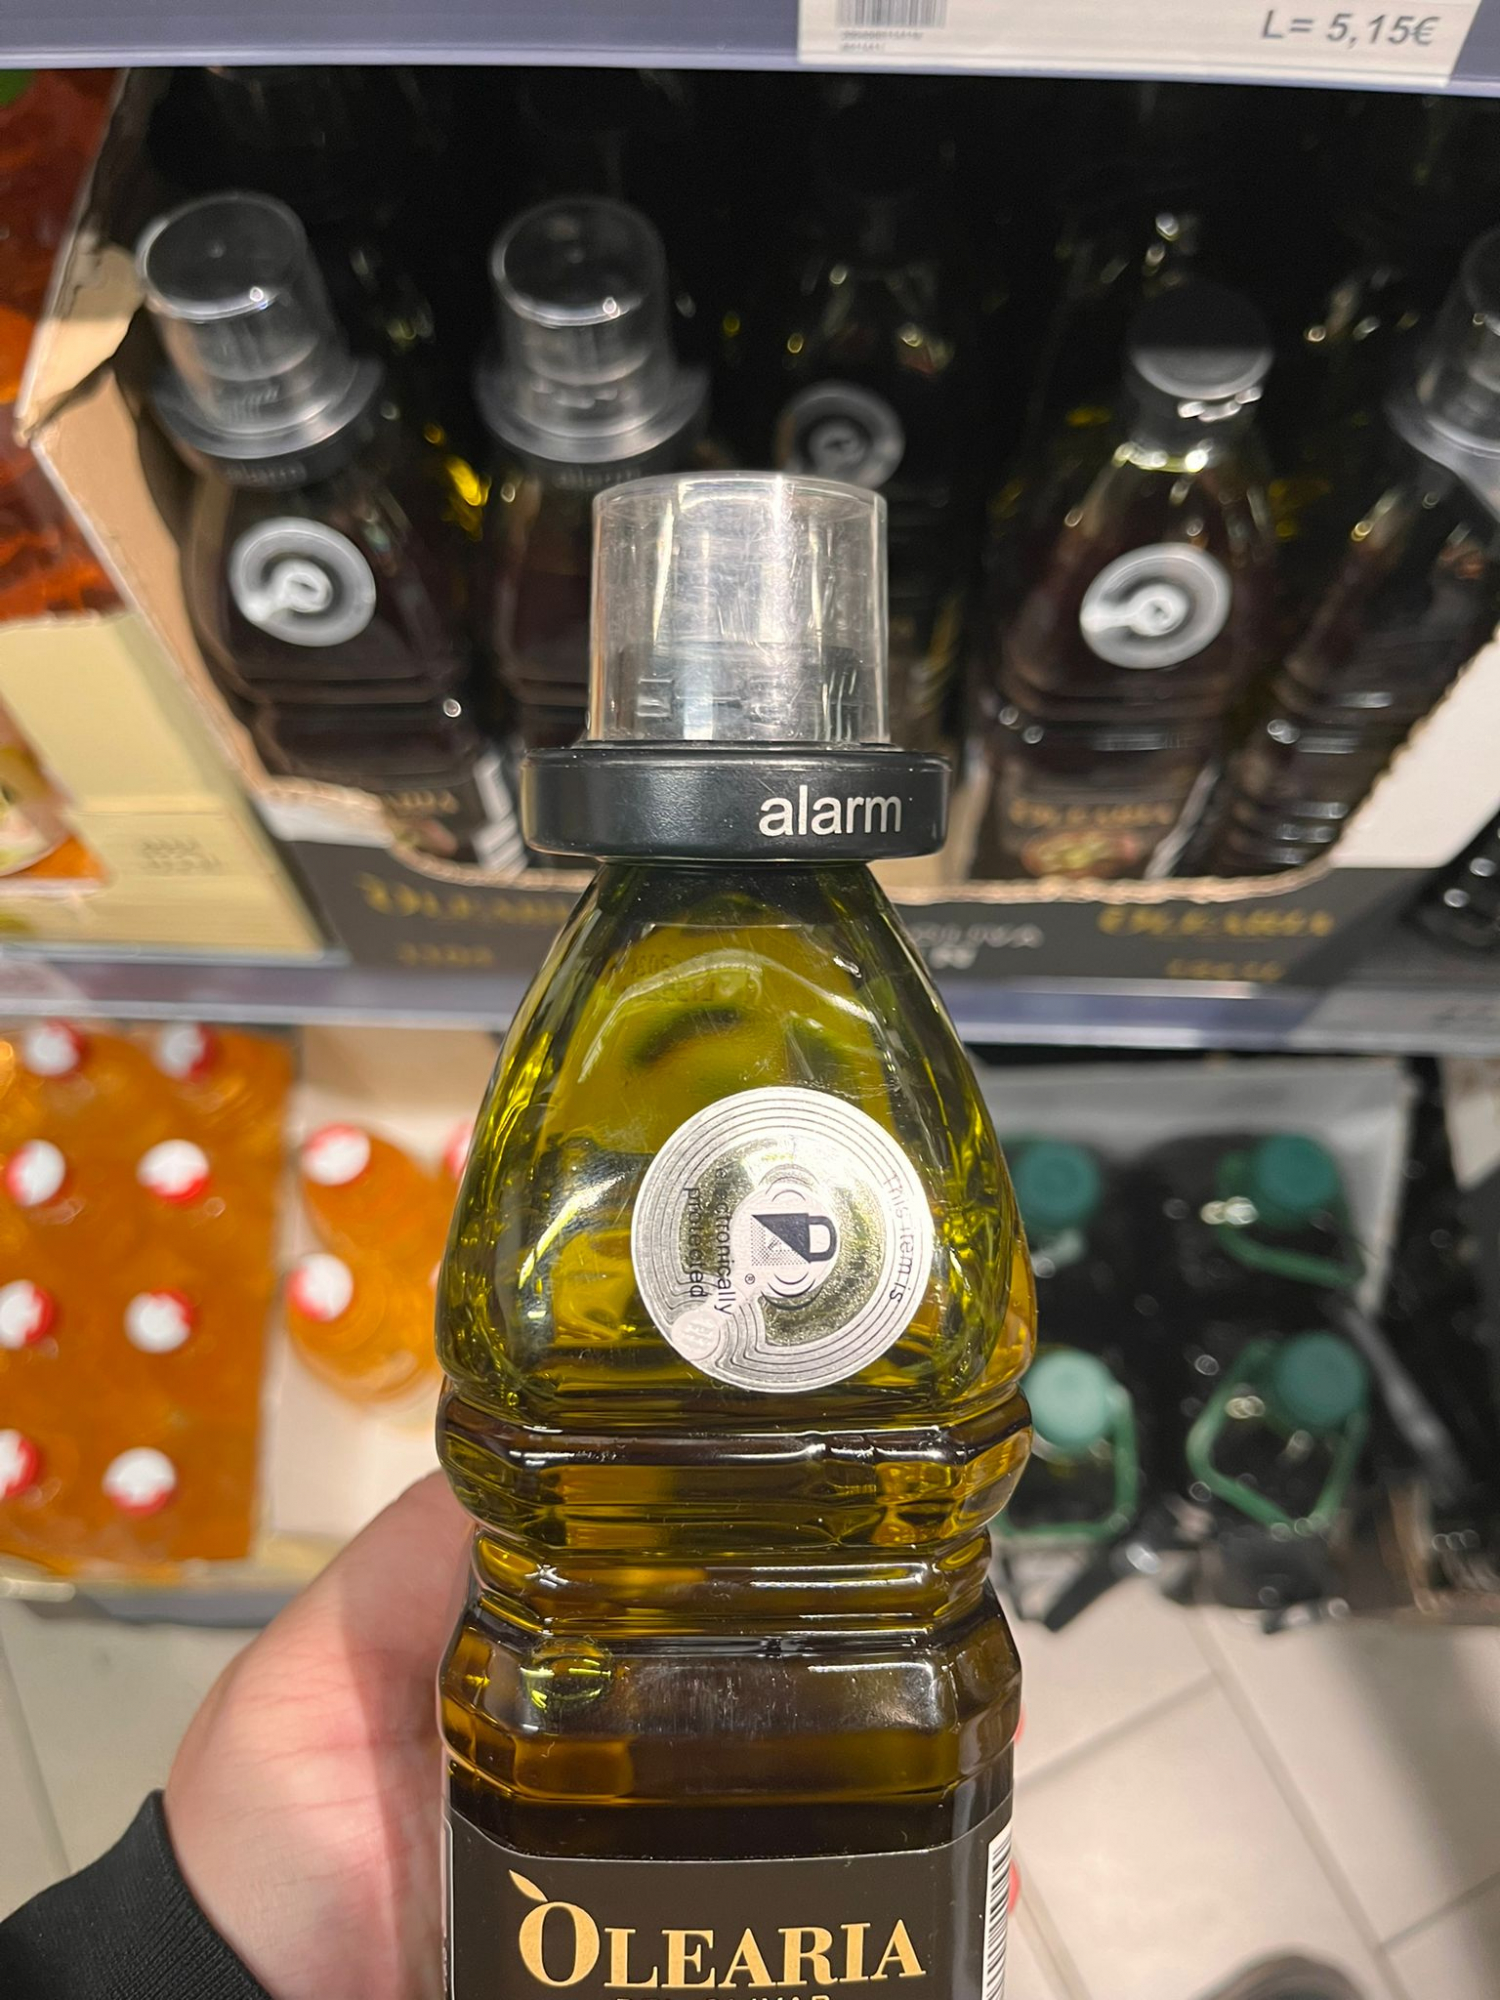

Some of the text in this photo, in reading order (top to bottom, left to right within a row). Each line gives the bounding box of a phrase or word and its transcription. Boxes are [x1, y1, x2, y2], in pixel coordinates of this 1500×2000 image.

[1262, 10, 1441, 50] L= 5,15€
[758, 784, 902, 837] alarm
[683, 1187, 709, 1298] protected
[713, 1167, 736, 1316] electronically
[882, 1170, 916, 1304] This item is
[518, 1900, 927, 1990] OLEARIA
